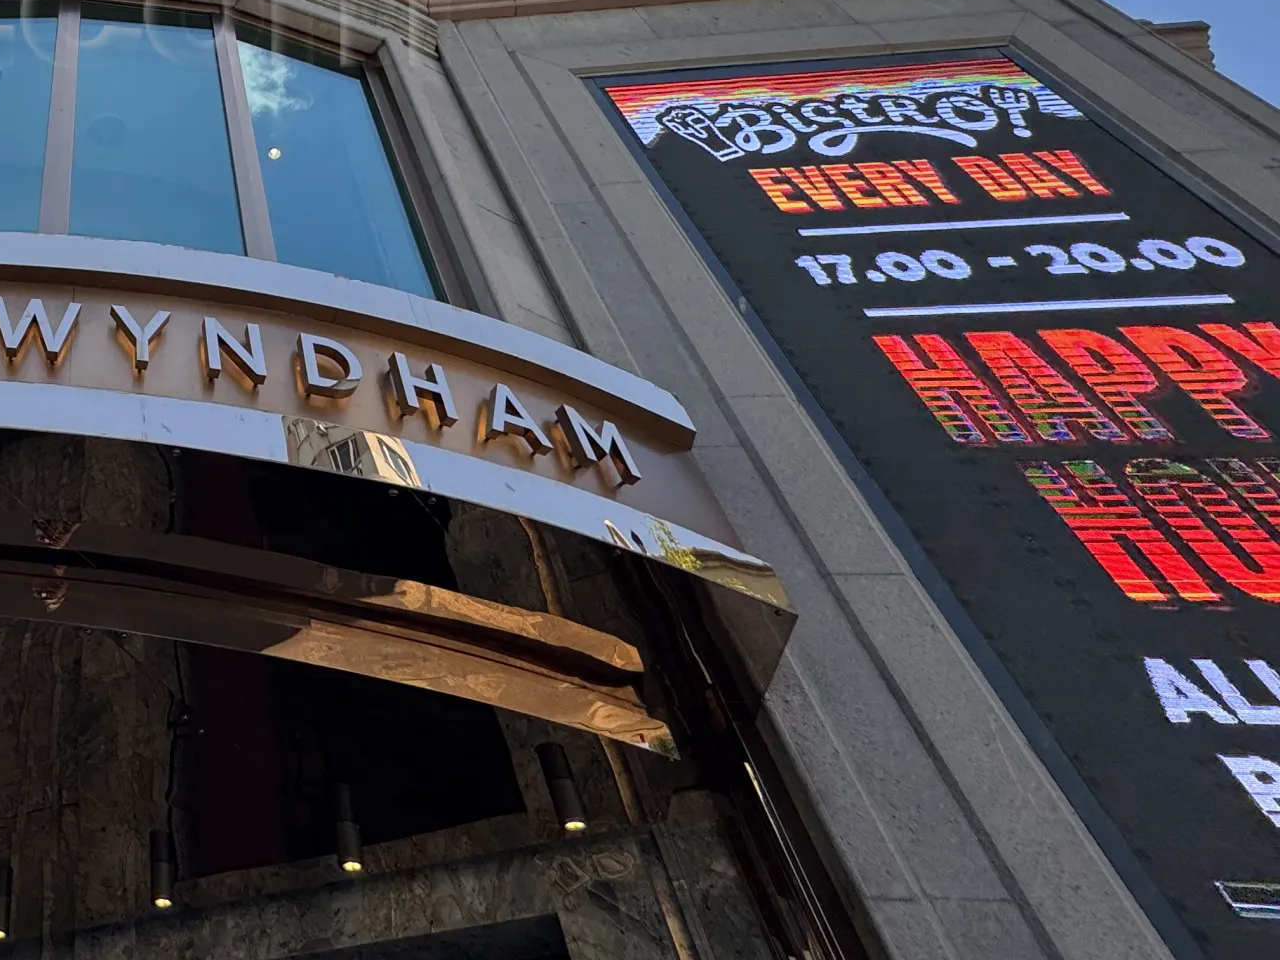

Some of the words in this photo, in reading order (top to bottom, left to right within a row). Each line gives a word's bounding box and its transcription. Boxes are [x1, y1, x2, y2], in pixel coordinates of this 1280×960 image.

[748, 159, 961, 214] EVERY
[951, 150, 1112, 202] DAY
[794, 250, 972, 285] 17.00
[1023, 236, 1246, 274] 20.00
